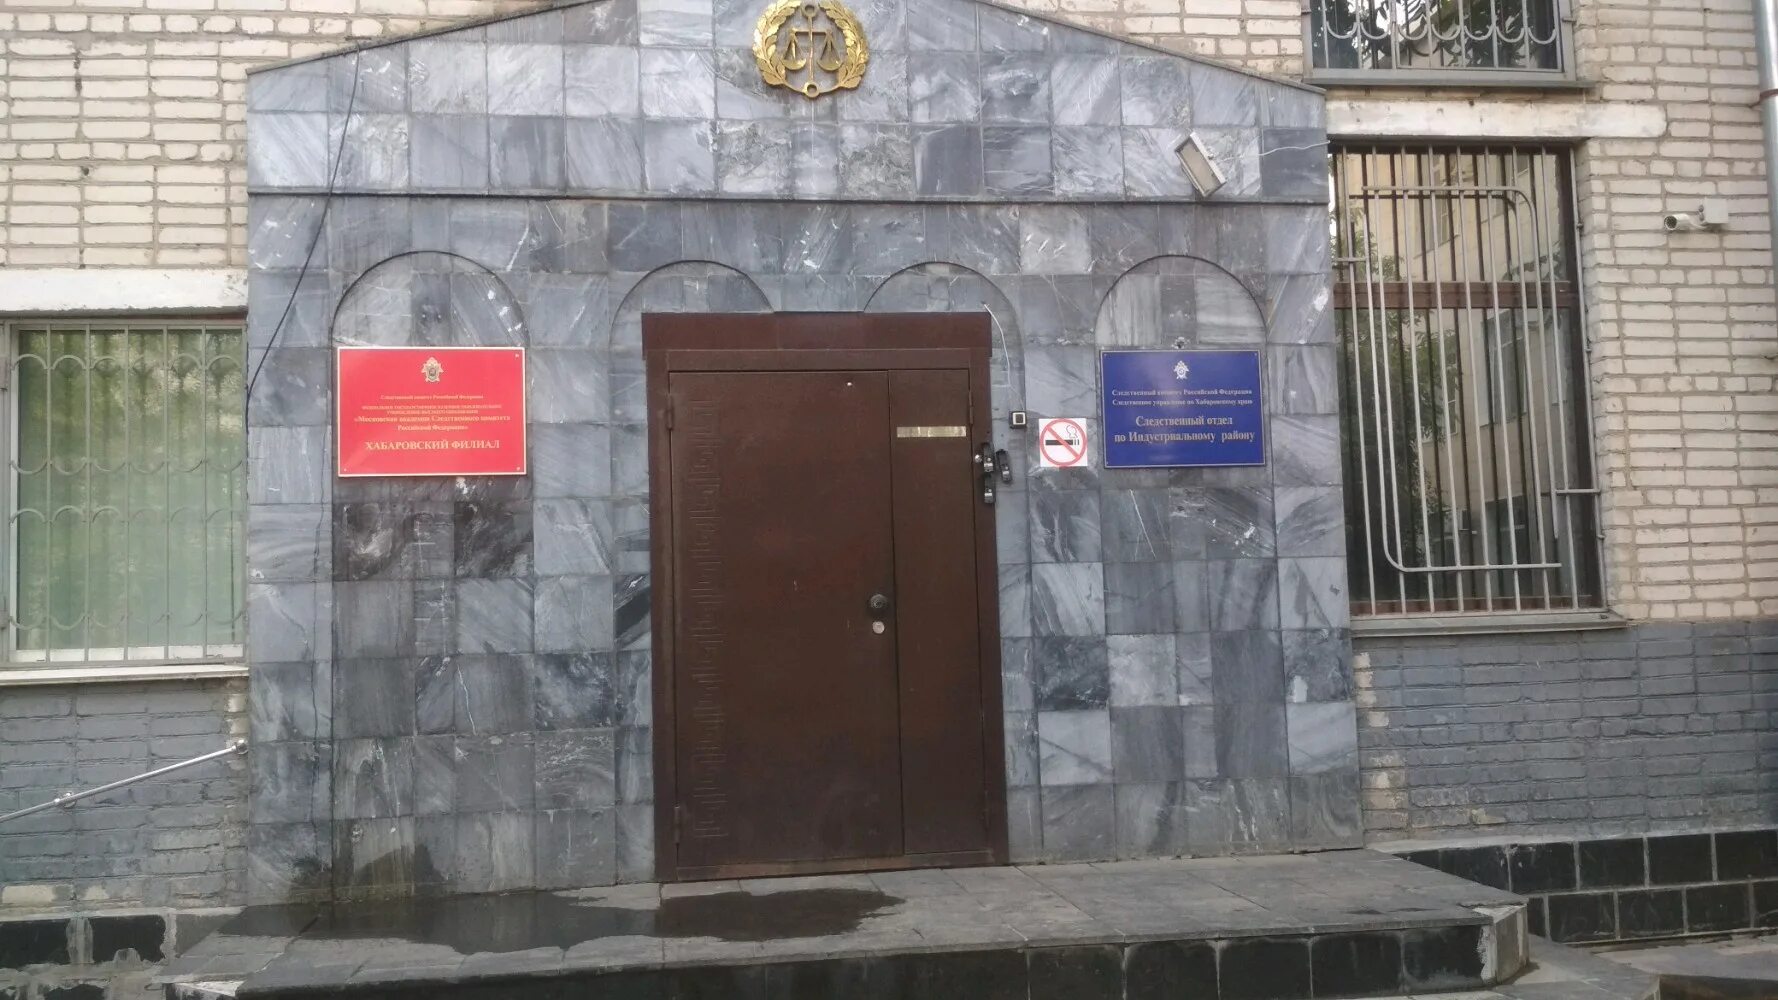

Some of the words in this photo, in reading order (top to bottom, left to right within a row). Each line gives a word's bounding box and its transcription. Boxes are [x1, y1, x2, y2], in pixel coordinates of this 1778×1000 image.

[1219, 389, 1252, 397] Федерации
[1195, 398, 1237, 407] Хабаровскому
[1135, 415, 1205, 428] Следственный
[1206, 416, 1233, 426] отдел
[1114, 433, 1126, 443] по
[1128, 431, 1216, 445] Индустриальному
[1221, 430, 1255, 444] району
[365, 438, 449, 451] ХАБАРОВСКИЙ
[451, 438, 500, 450] ФИЛИАЛ
